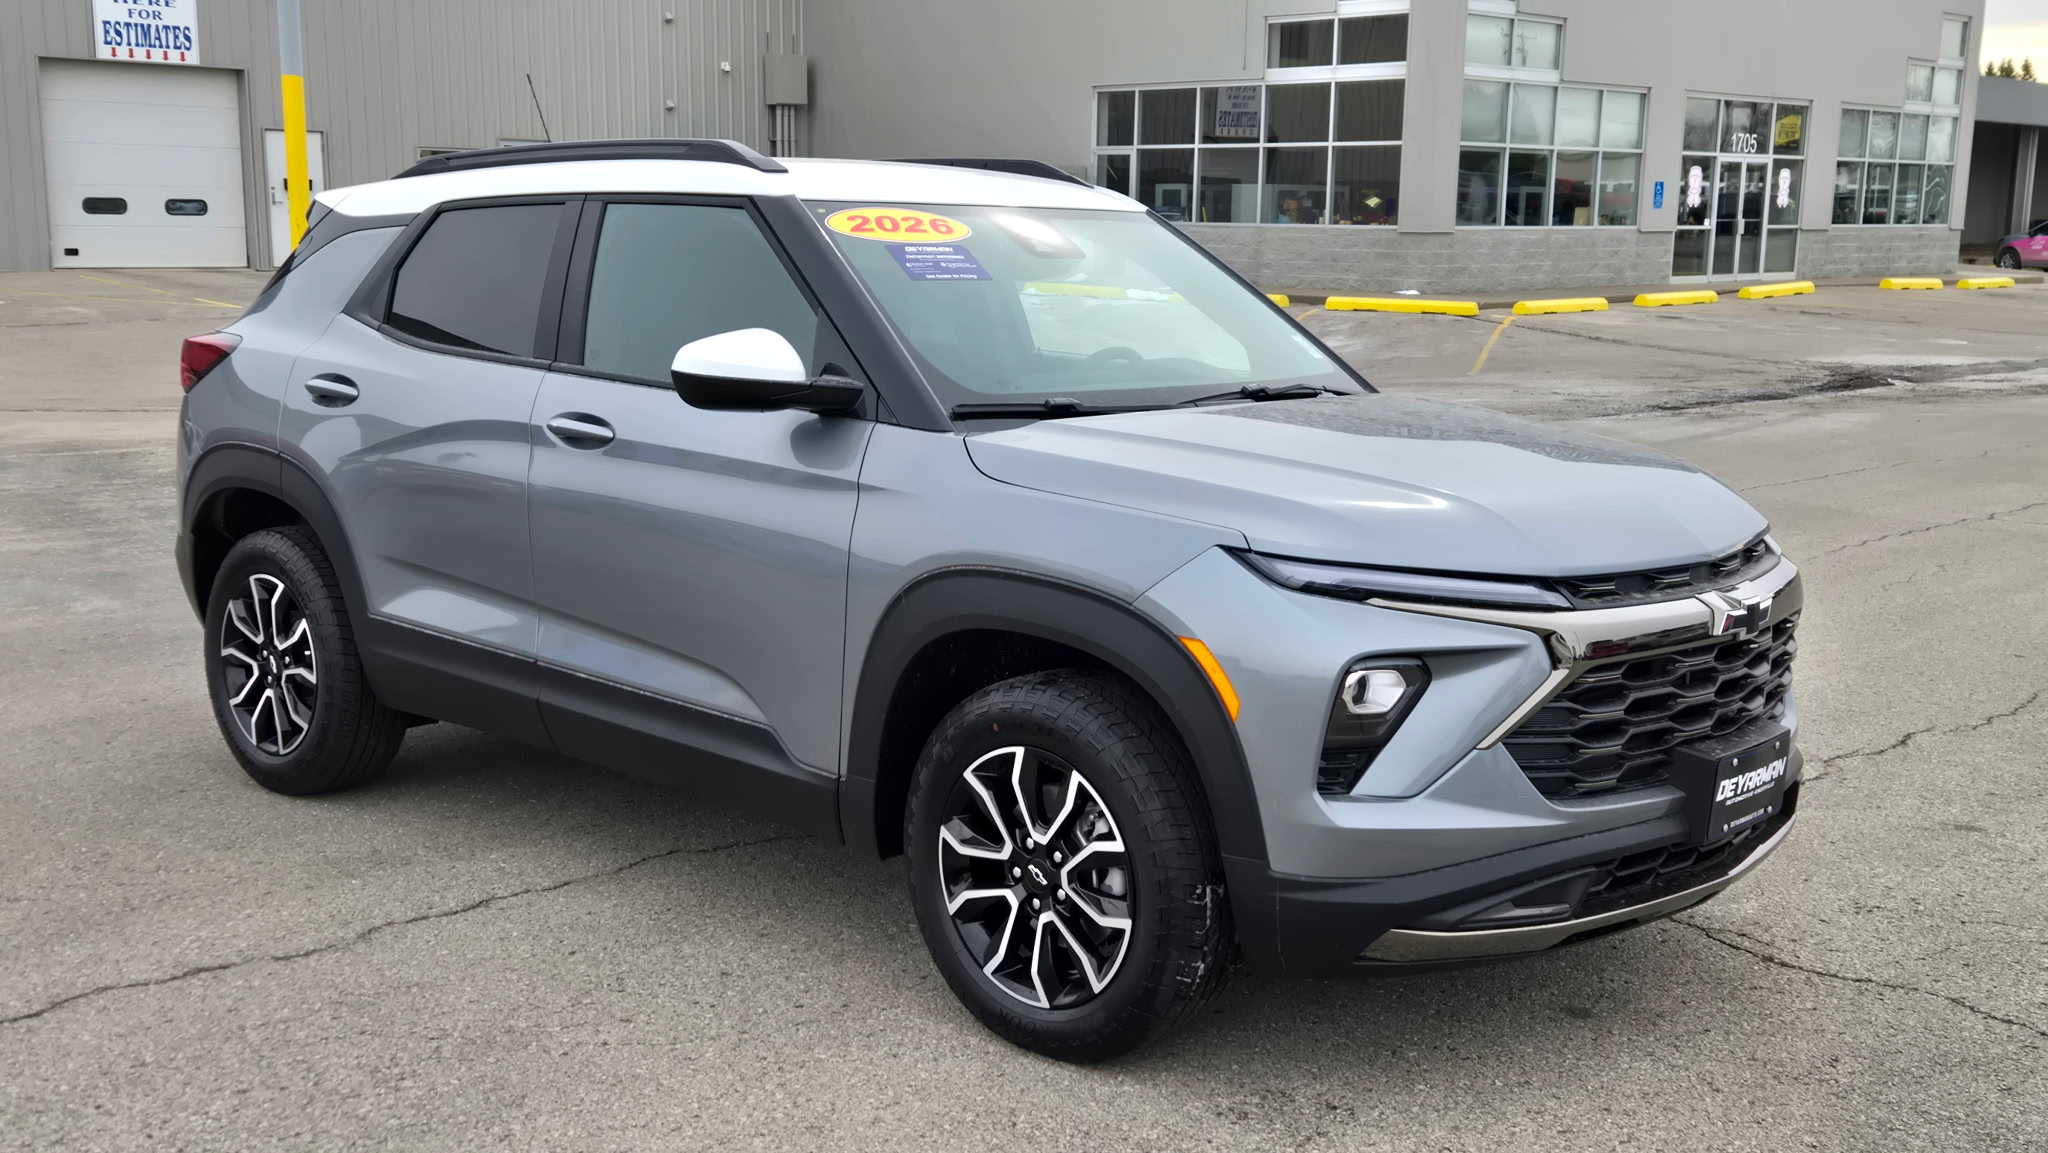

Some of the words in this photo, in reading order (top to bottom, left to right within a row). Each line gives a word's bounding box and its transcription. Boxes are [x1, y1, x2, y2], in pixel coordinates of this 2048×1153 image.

[127, 8, 163, 20] FOR
[102, 20, 192, 51] ESTIMATES
[1731, 133, 1758, 153] 1705
[846, 214, 956, 235] 2026
[1716, 757, 1787, 802] DEYARMAN
